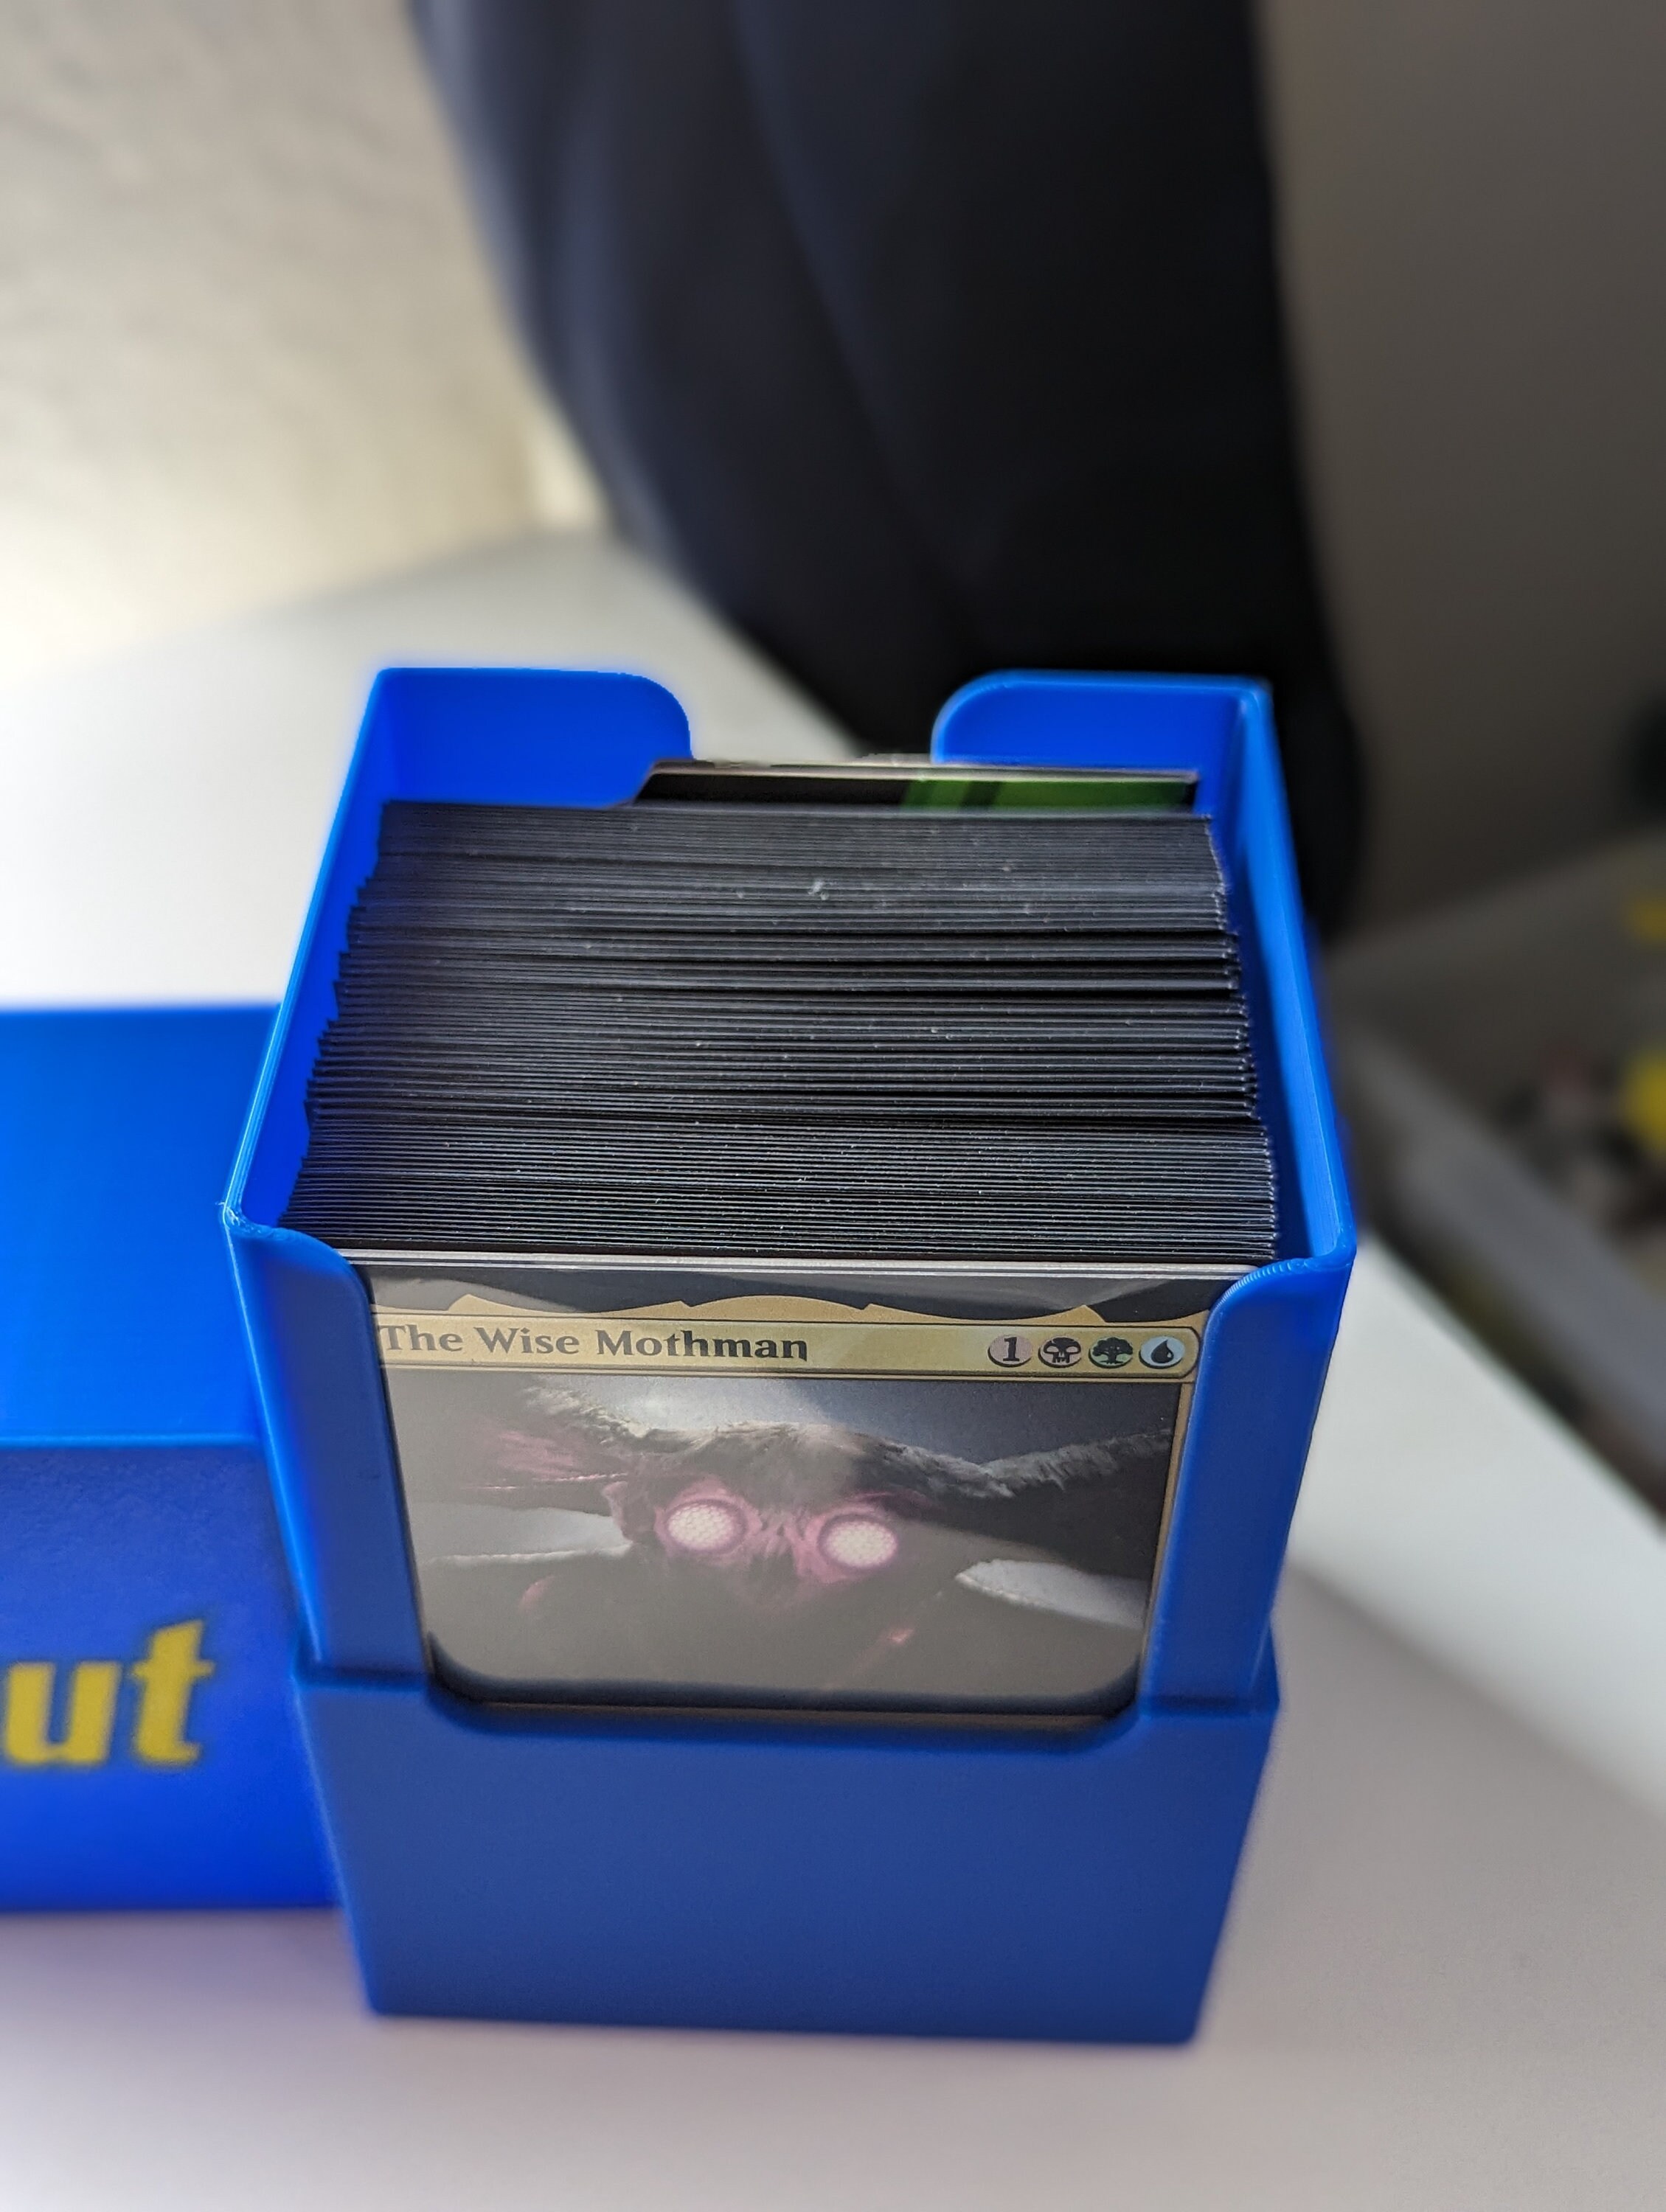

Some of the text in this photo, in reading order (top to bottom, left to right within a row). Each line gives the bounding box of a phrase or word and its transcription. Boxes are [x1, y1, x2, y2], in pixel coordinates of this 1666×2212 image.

[378, 1324, 808, 1361] The Wise Mothman
[1002, 1337, 1020, 1362] 1
